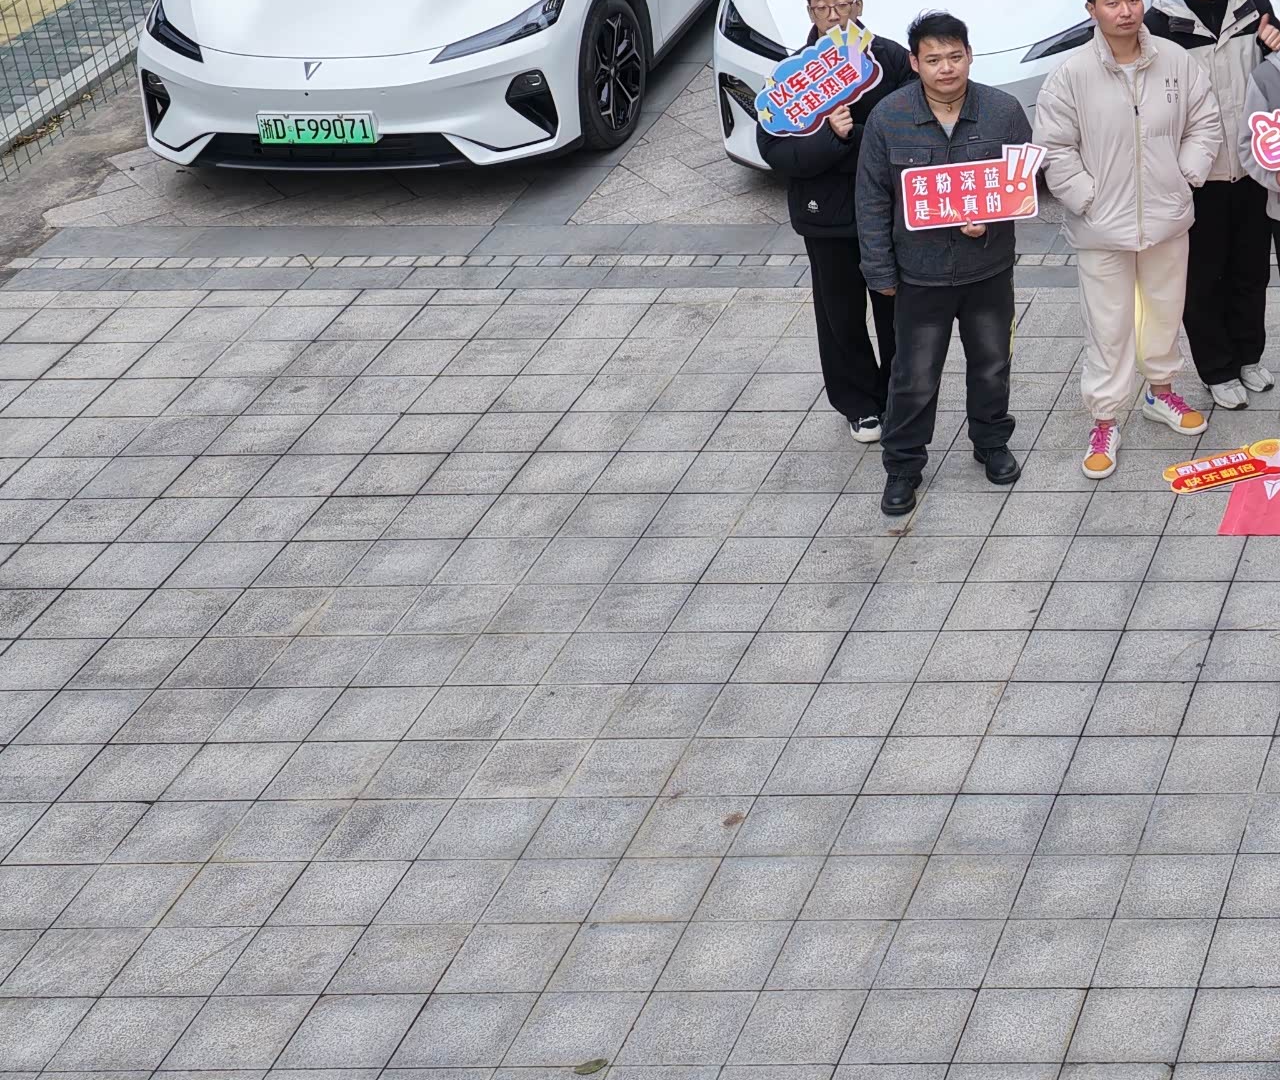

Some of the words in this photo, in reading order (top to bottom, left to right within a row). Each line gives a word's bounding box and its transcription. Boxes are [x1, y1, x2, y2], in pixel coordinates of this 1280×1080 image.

[768, 46, 845, 107] 以车会友
[785, 62, 860, 124] 共赴热爱
[294, 118, 370, 140] F99071
[914, 192, 1002, 221] 是认真的
